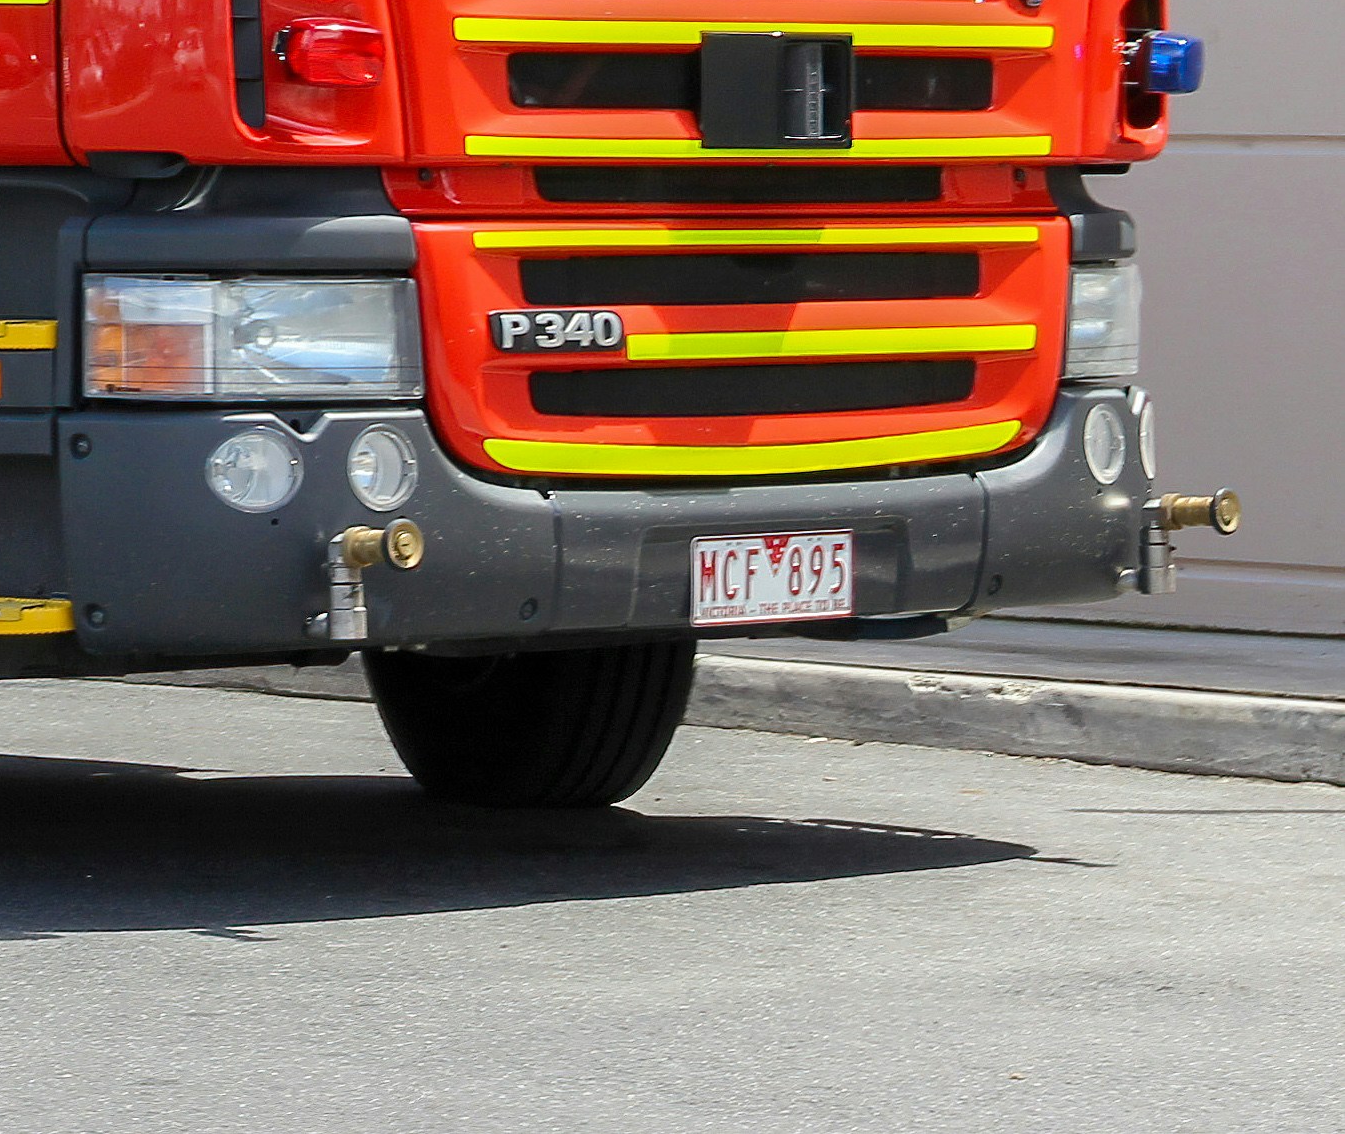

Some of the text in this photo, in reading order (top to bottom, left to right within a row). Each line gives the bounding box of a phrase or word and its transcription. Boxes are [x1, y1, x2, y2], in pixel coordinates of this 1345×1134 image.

[499, 312, 622, 349] P 340
[700, 542, 847, 602] MCF 895
